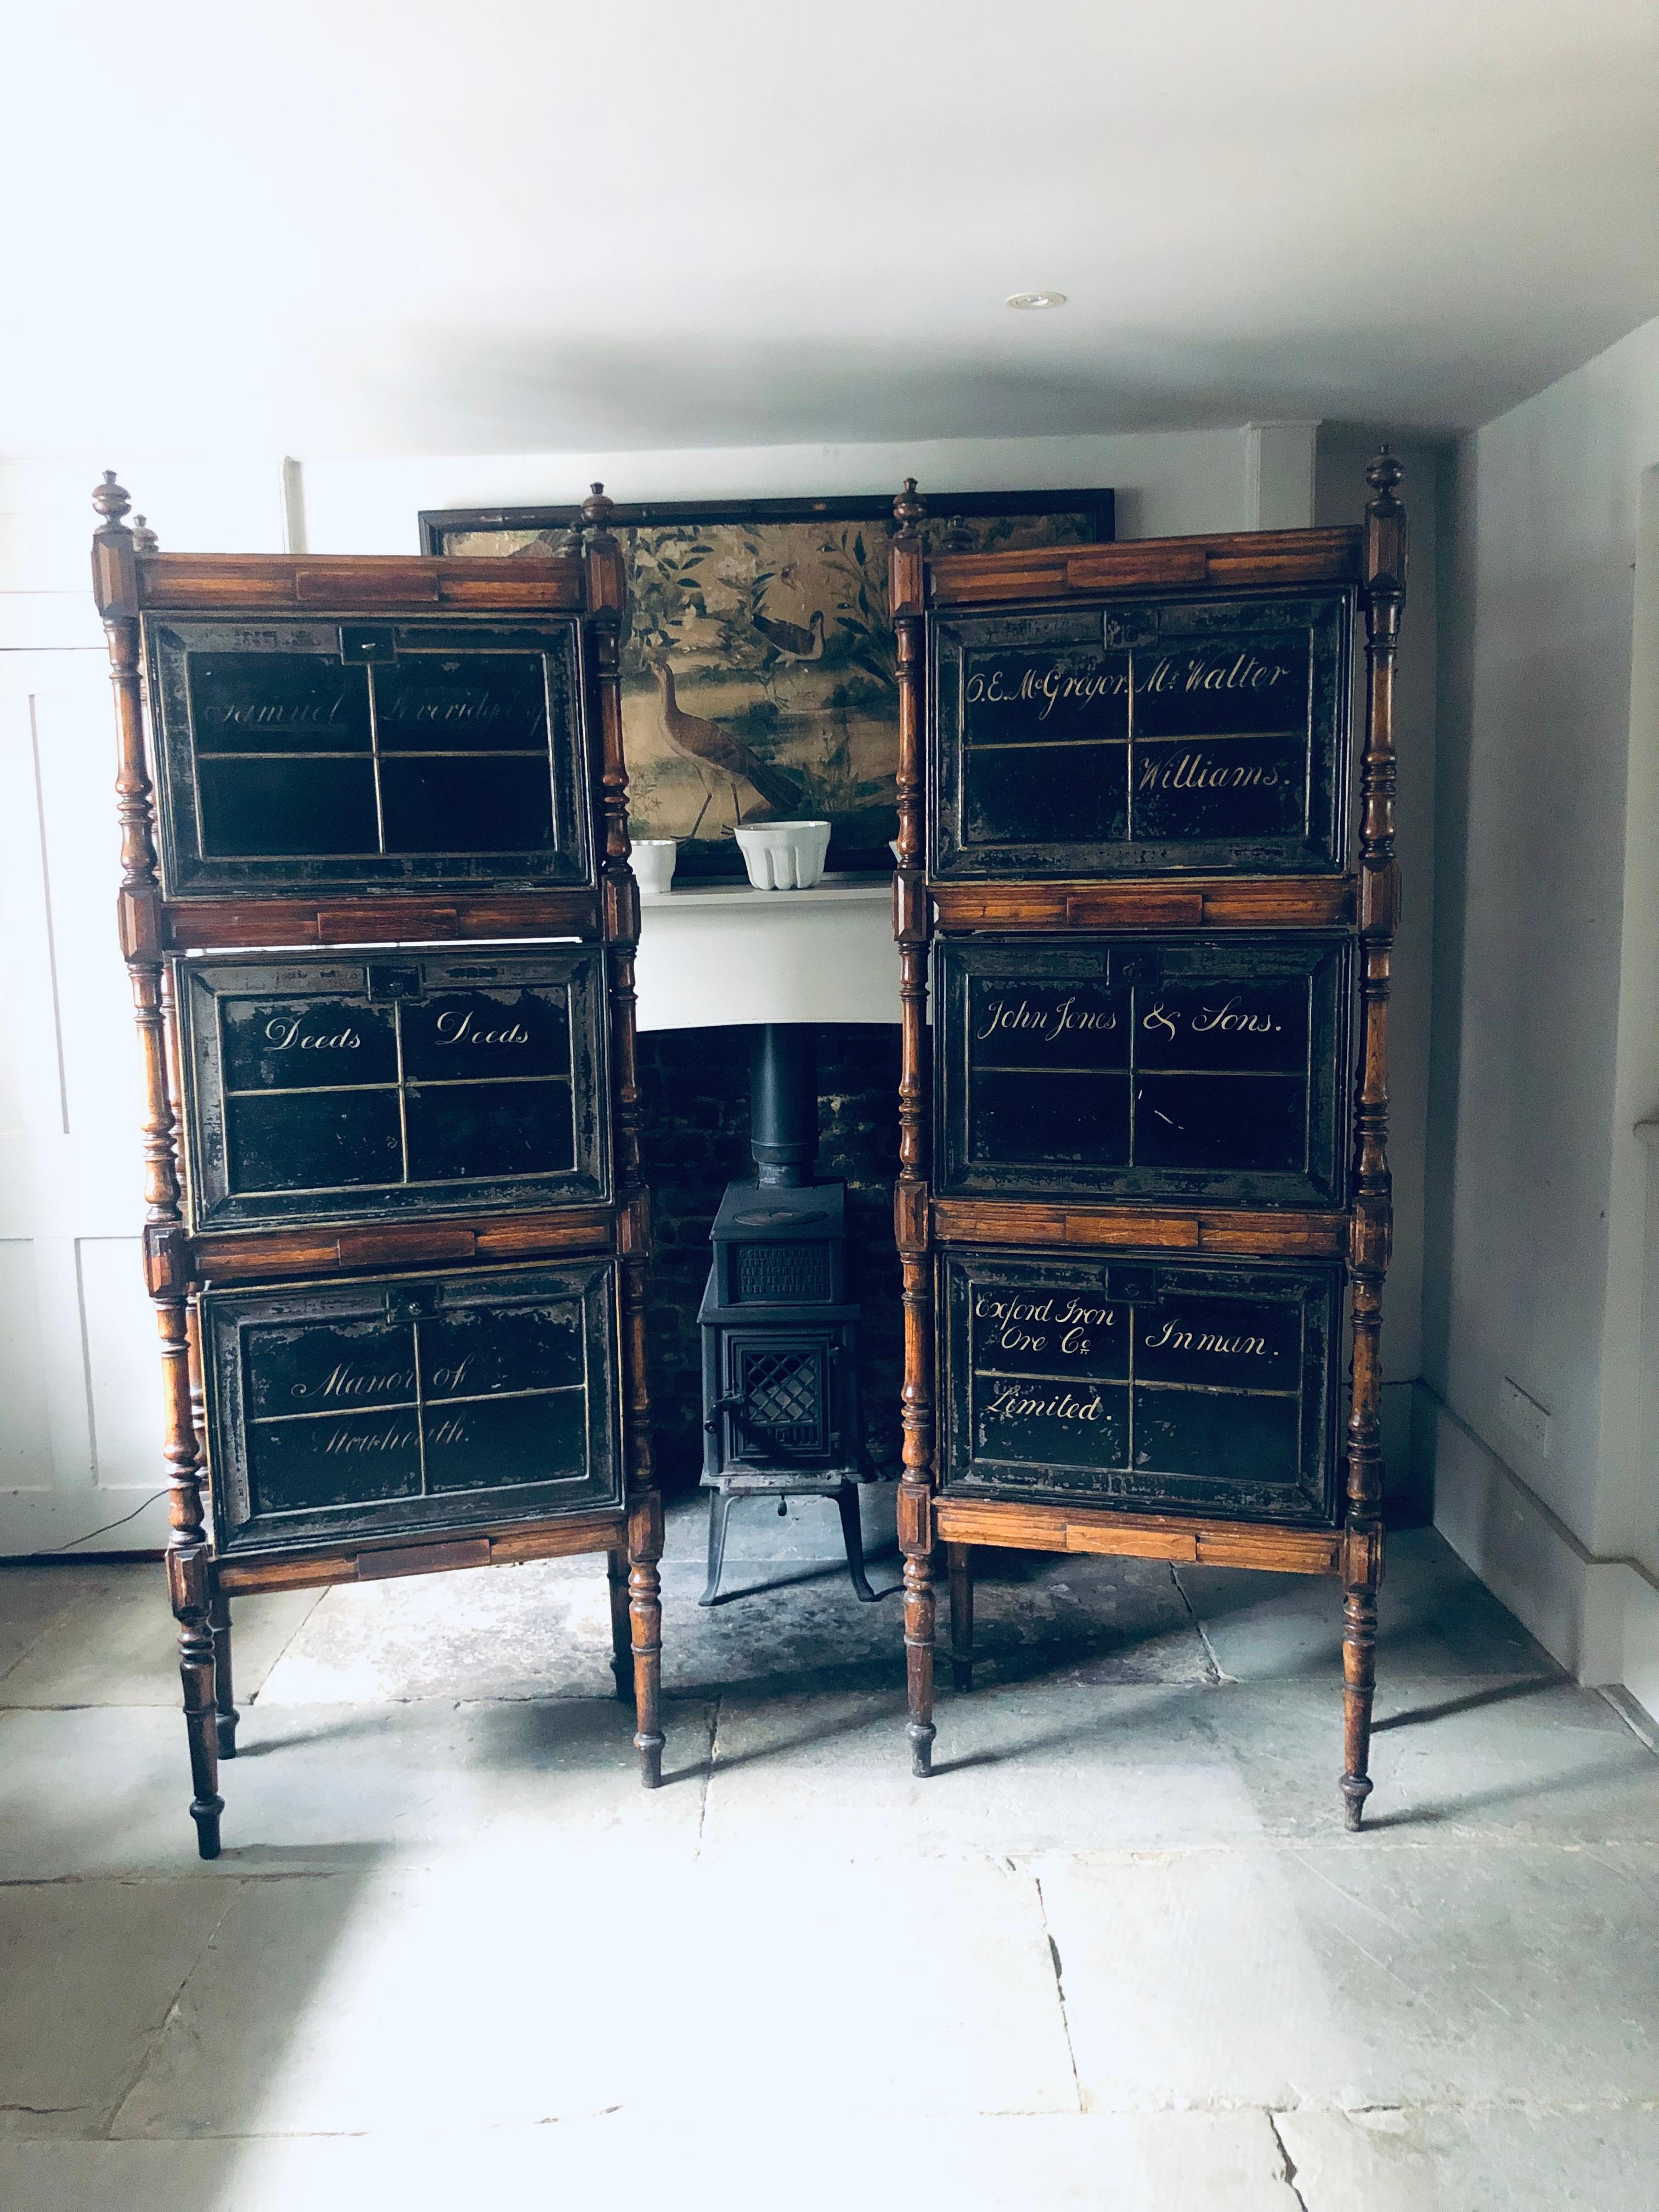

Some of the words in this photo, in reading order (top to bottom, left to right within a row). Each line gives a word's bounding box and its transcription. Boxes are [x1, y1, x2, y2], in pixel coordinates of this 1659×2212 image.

[1185, 650, 1290, 693] Walter
[263, 1017, 361, 1051] Deeds
[436, 1011, 529, 1045] Deeds
[977, 1000, 1048, 1040] John
[1045, 996, 1117, 1041] Jones
[1143, 1001, 1181, 1042] &
[975, 1291, 1054, 1330] Exford
[1055, 1297, 1118, 1326] Iron
[1001, 1324, 1049, 1351] Ore
[291, 1361, 414, 1398] Manor
[432, 1351, 475, 1392] of
